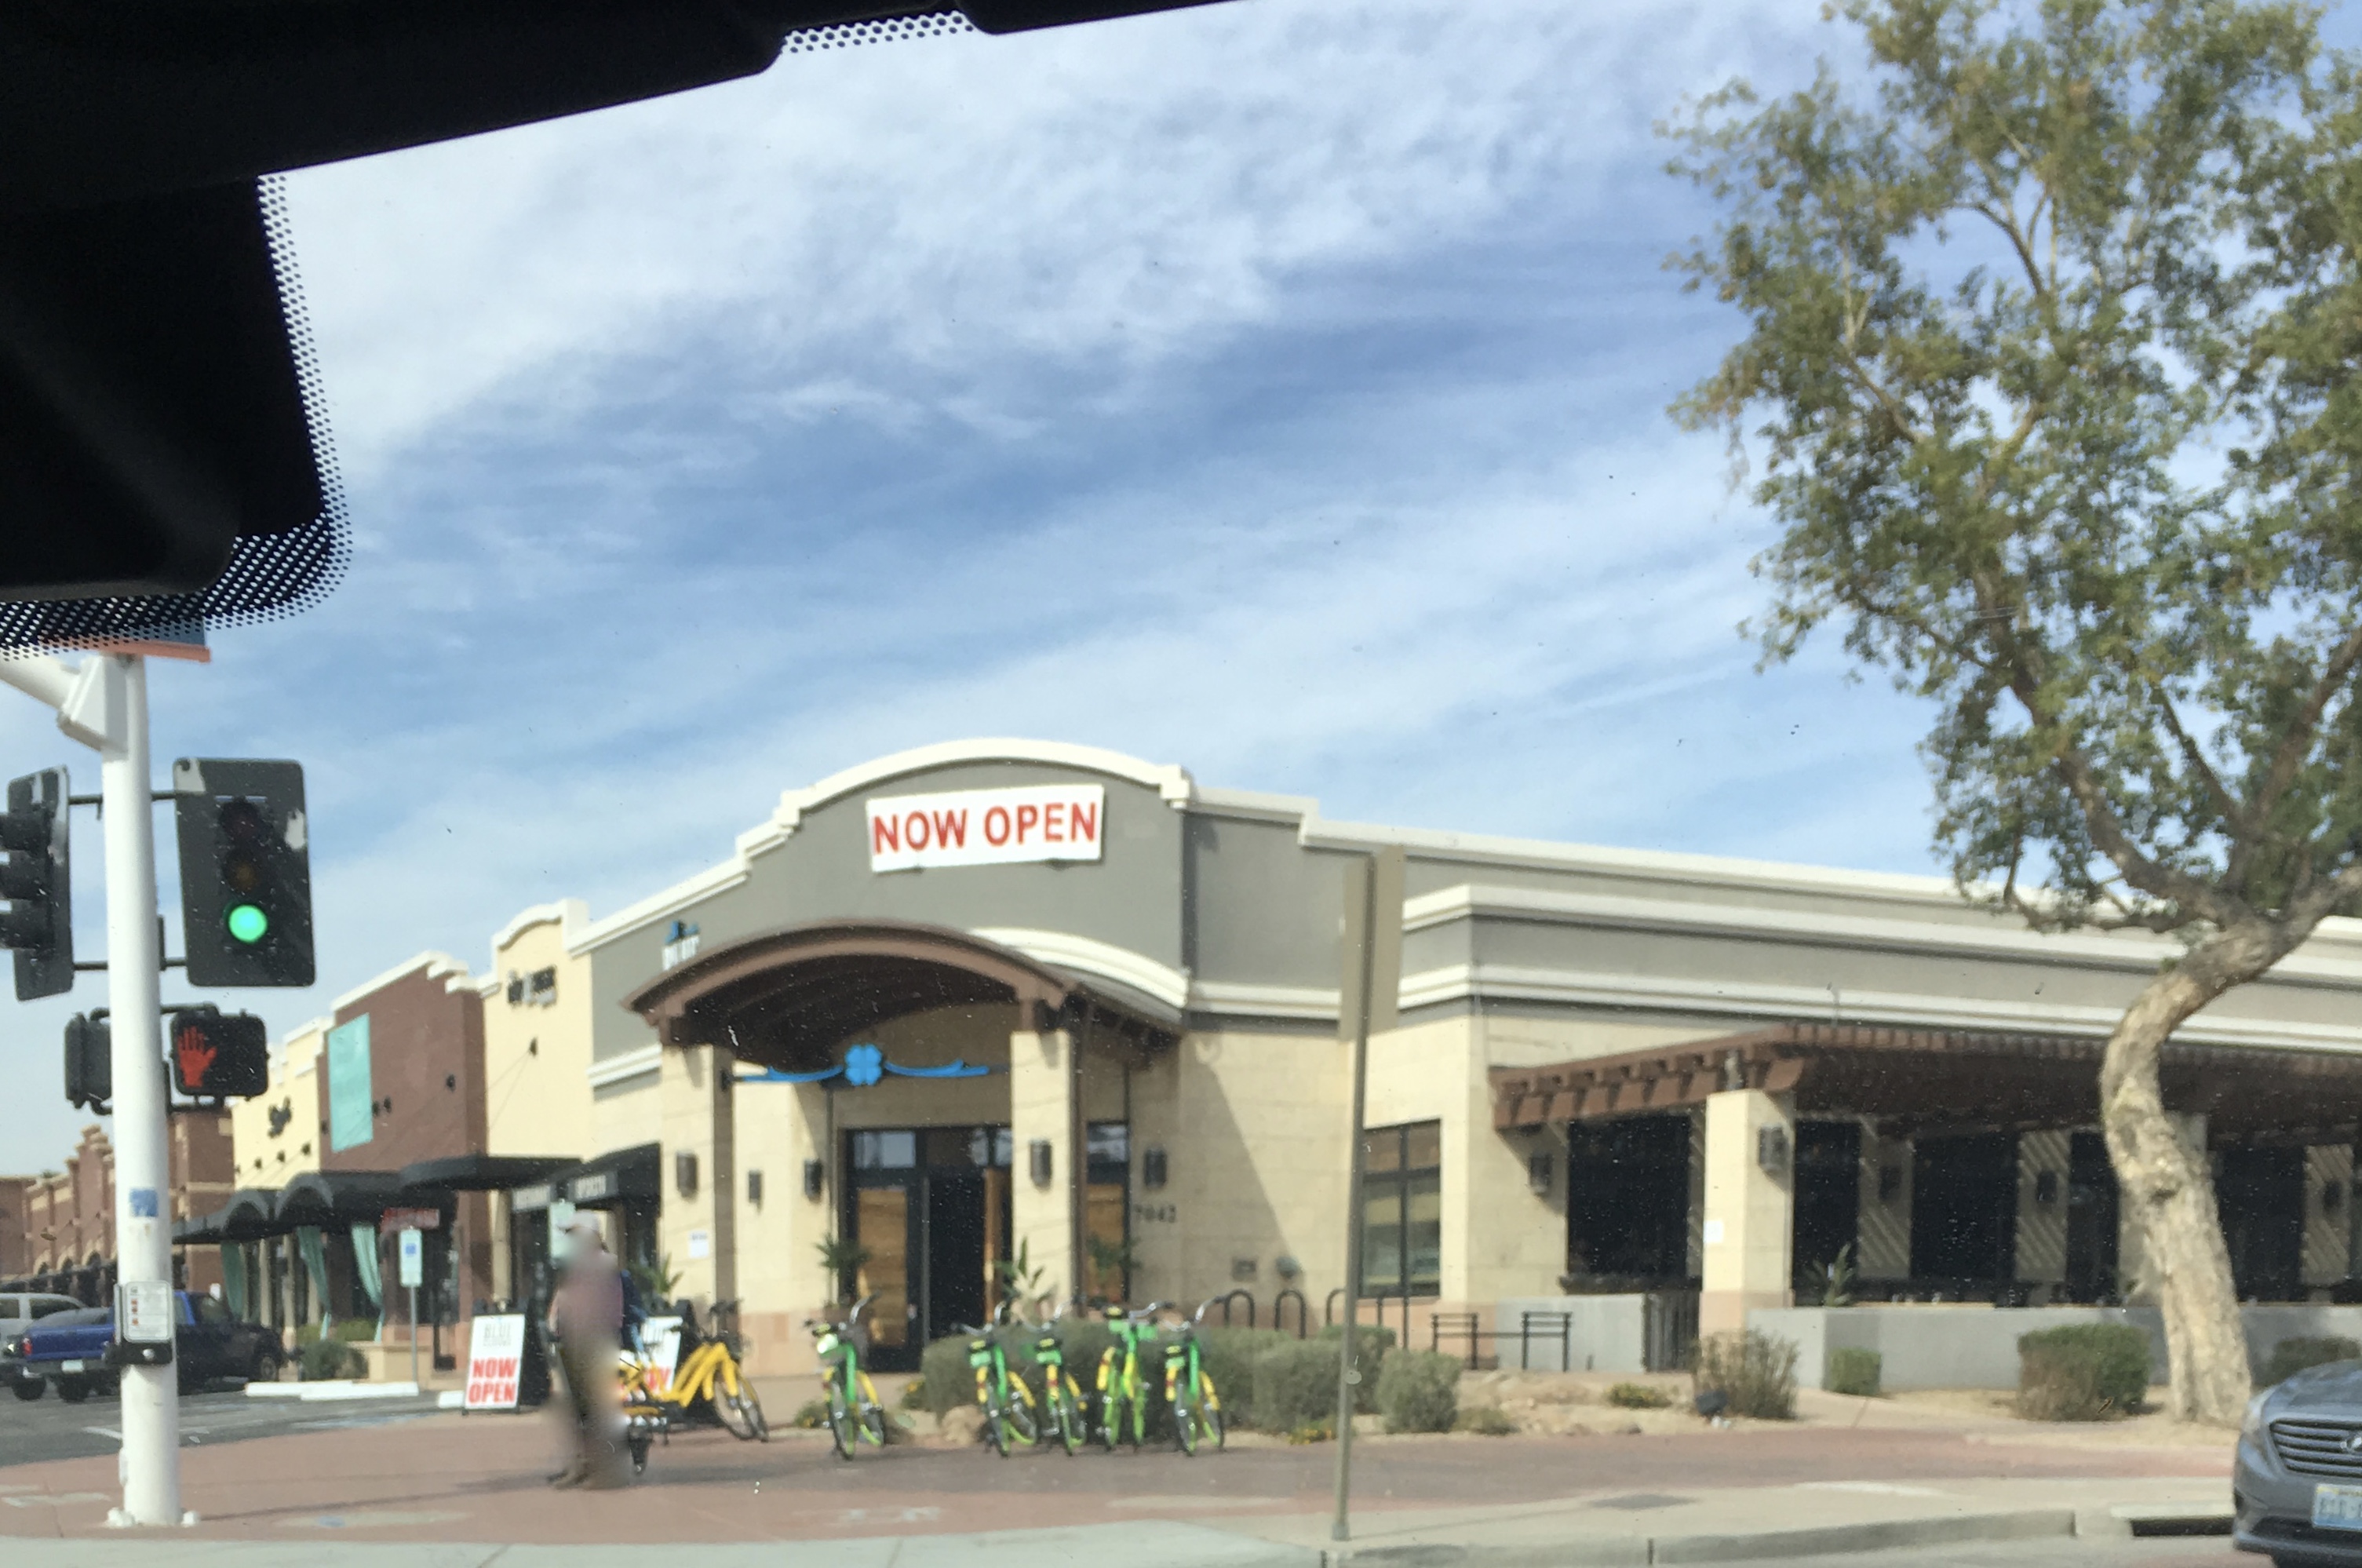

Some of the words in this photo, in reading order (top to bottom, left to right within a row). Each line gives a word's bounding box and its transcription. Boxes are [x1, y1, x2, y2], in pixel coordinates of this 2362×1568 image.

[873, 808, 968, 855] NOW
[983, 801, 1096, 847] OPEN
[472, 1357, 518, 1378] NOW
[468, 1382, 516, 1403] OPEN
